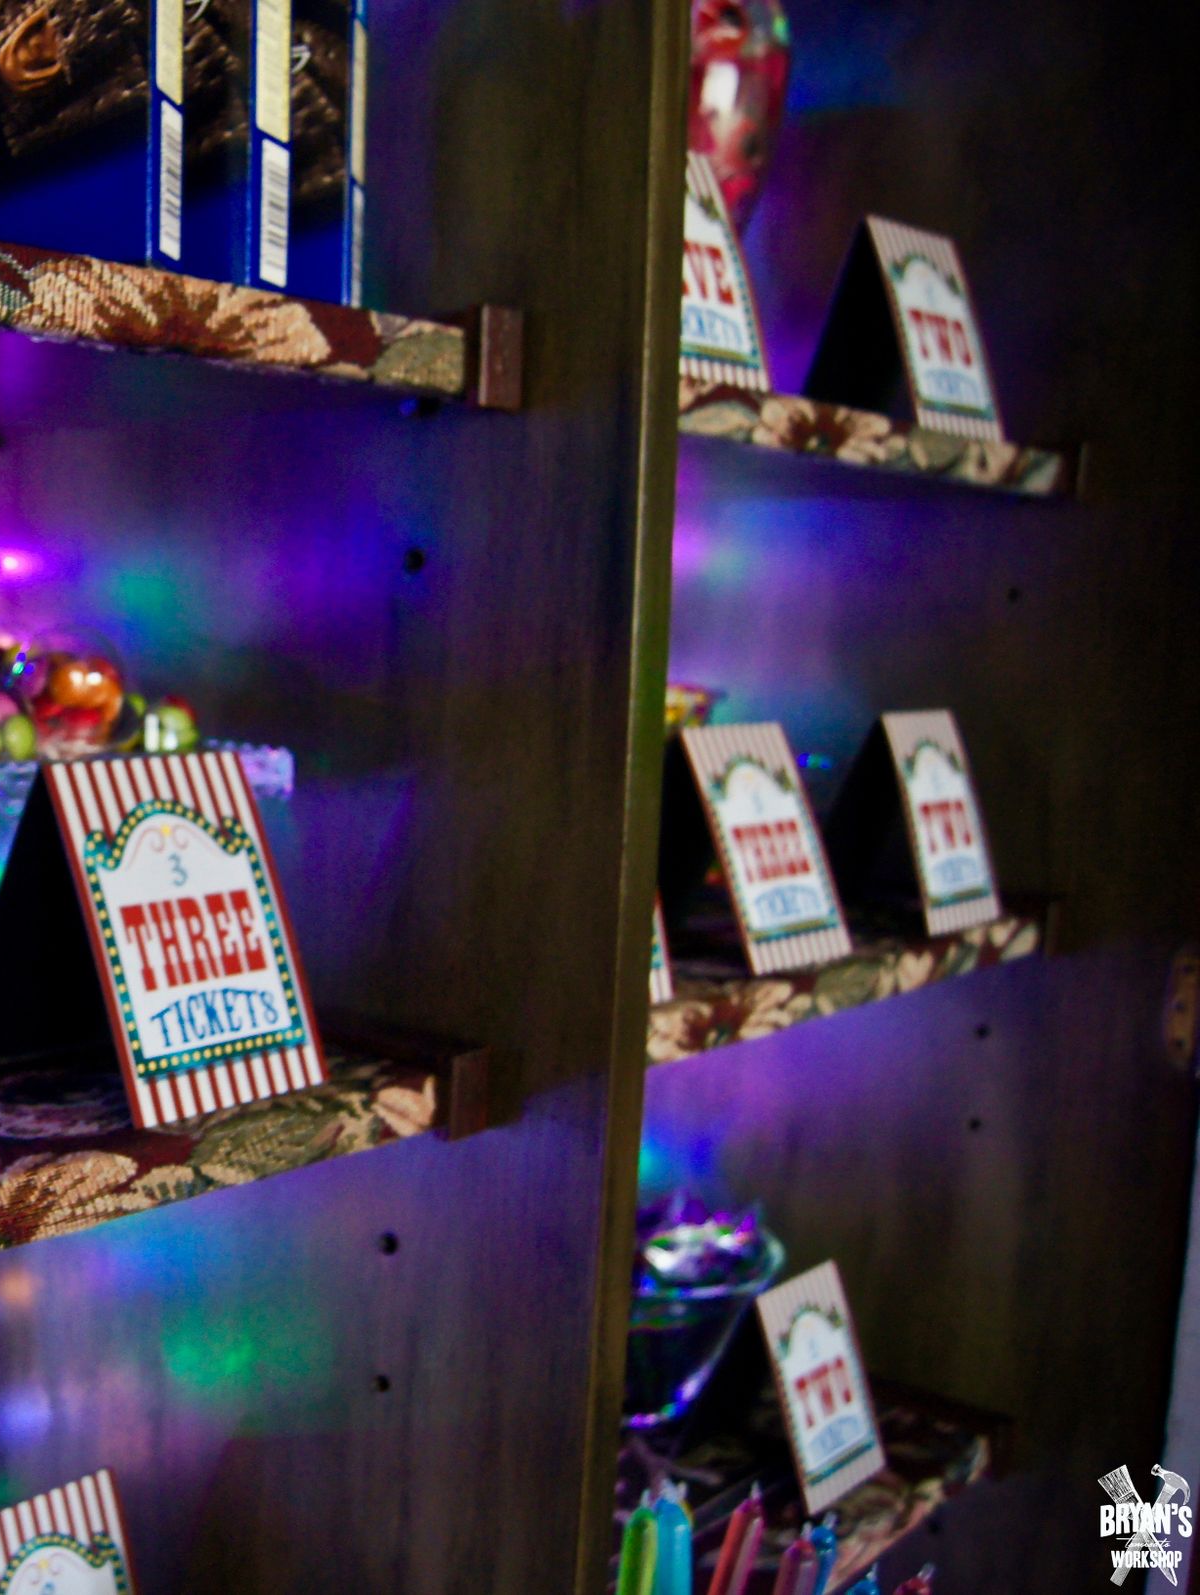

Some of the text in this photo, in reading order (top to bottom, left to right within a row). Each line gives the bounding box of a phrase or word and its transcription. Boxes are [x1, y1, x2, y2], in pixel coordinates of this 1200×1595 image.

[682, 239, 735, 306] VE
[169, 853, 188, 886] 3
[120, 889, 267, 992] THREE
[150, 987, 280, 1048] TICKETS
